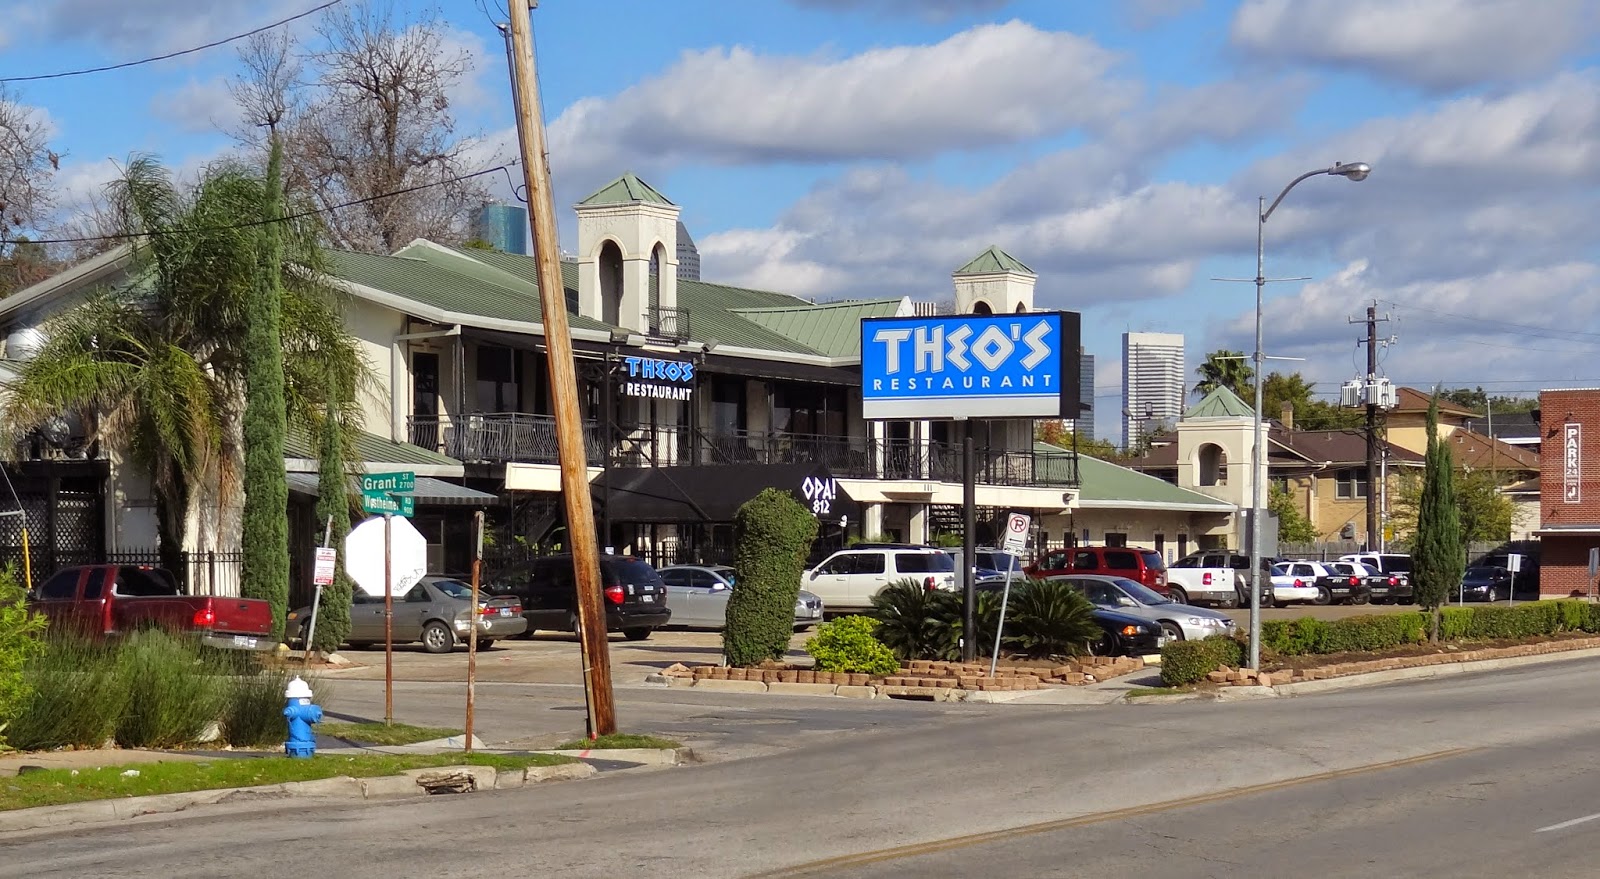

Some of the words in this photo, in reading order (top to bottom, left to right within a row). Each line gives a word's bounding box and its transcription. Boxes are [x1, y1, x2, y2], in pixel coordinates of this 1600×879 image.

[872, 319, 1053, 375] THEO'S
[625, 357, 694, 382] THEO'S
[627, 382, 692, 401] RESTAURANT
[873, 374, 1051, 391] RESTAURANT
[1567, 428, 1578, 468] PARK
[364, 476, 397, 490] Grant
[399, 481, 414, 489] 2700
[801, 476, 836, 500] OPA!
[812, 499, 830, 514] 812
